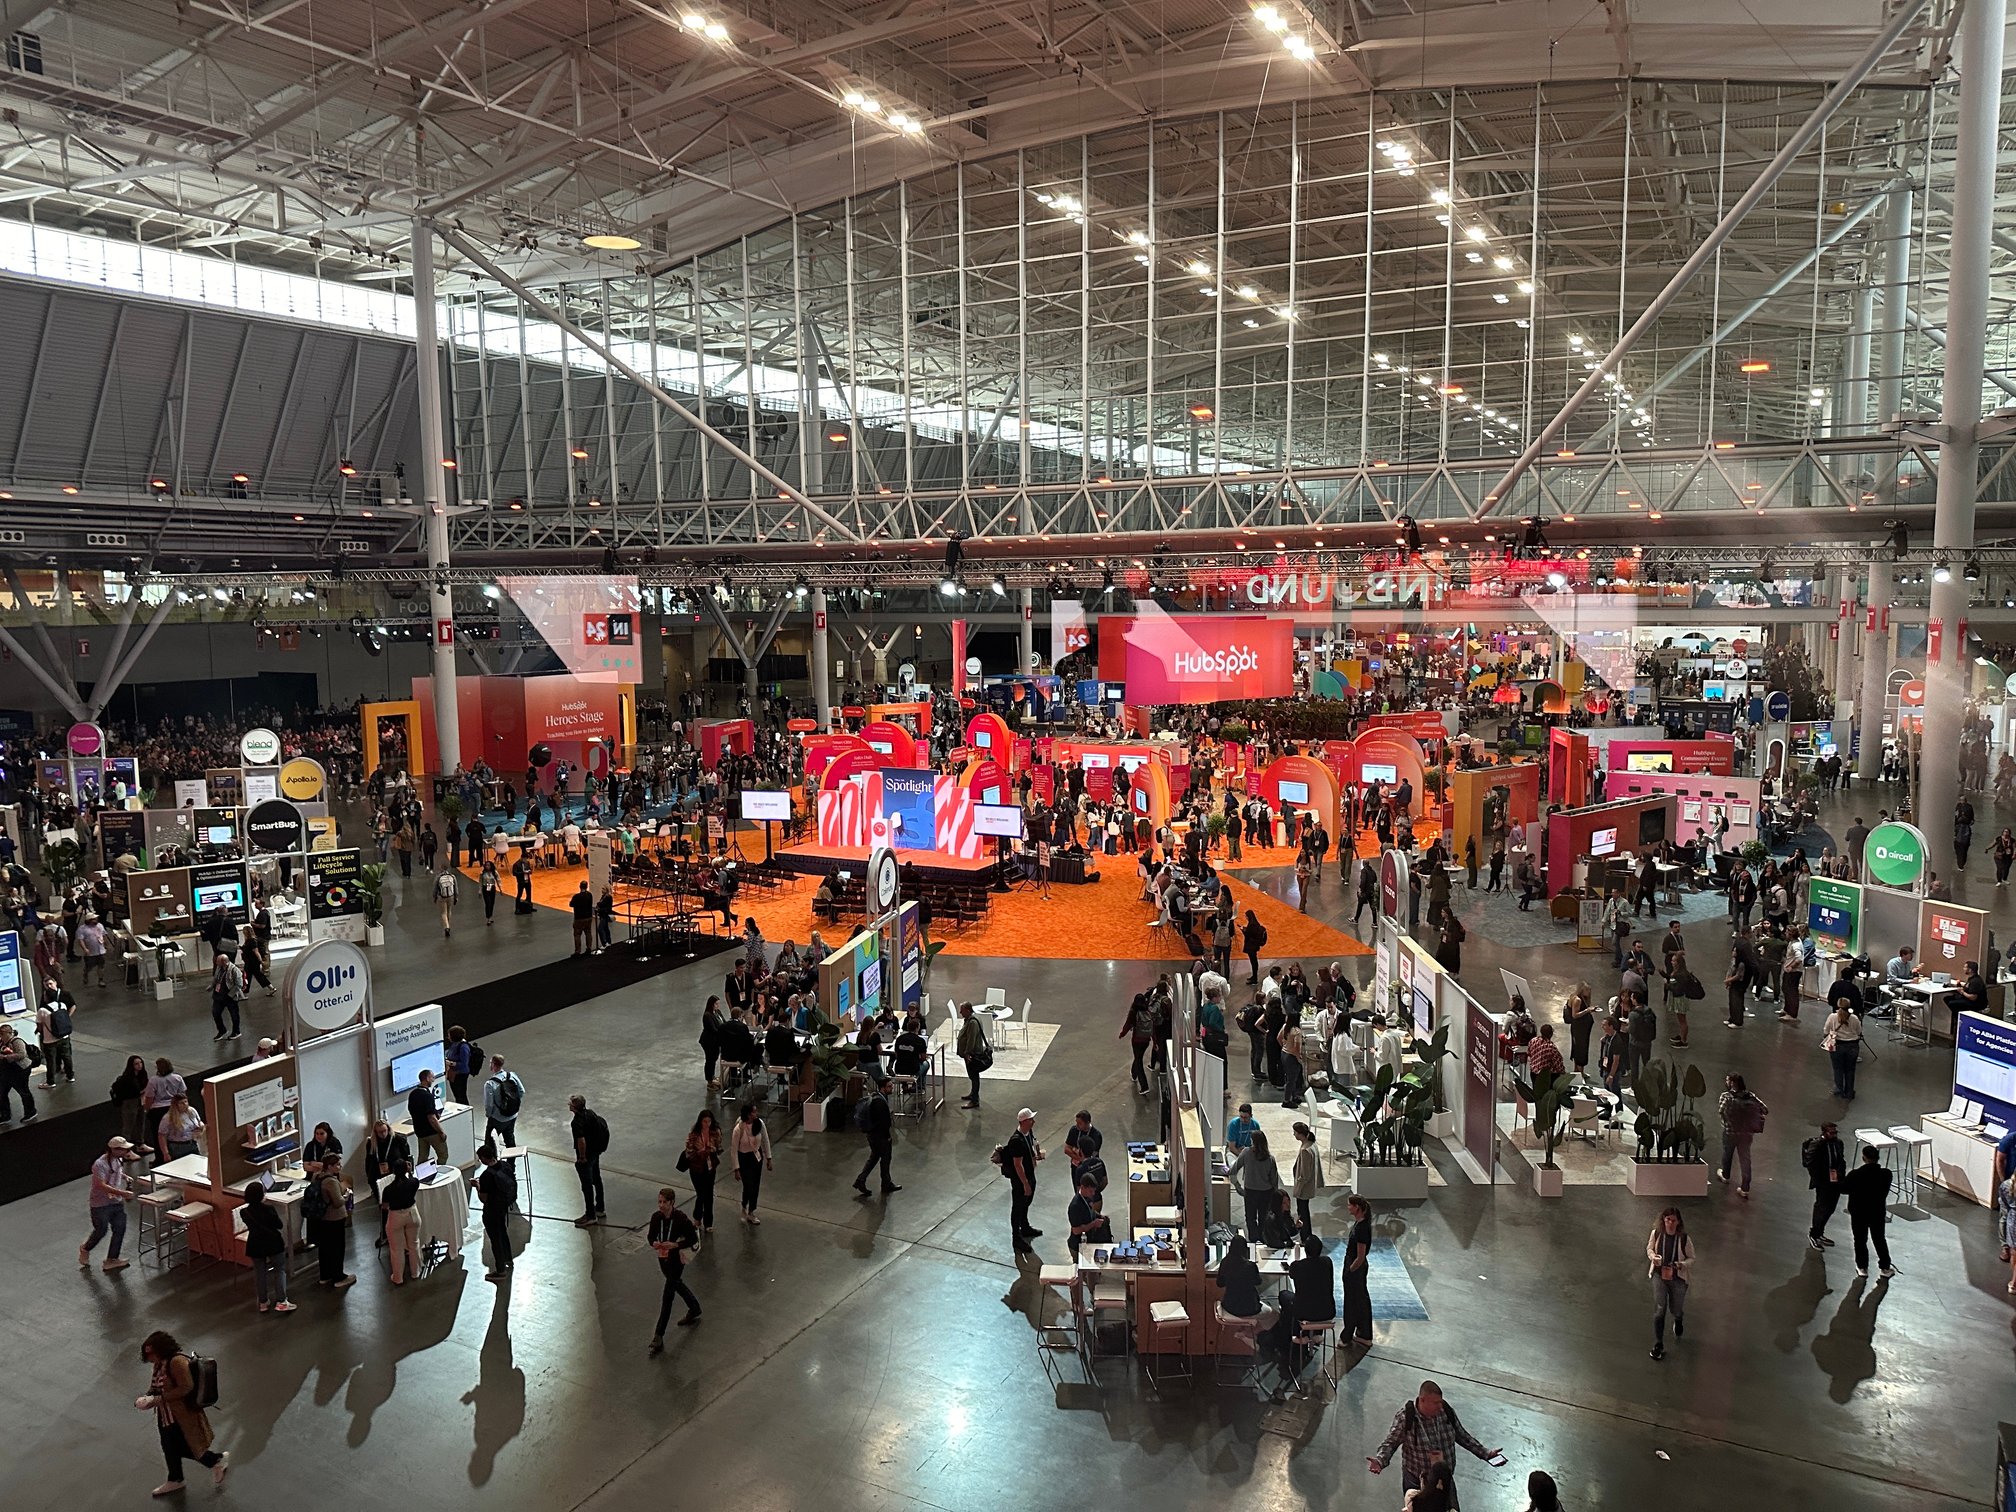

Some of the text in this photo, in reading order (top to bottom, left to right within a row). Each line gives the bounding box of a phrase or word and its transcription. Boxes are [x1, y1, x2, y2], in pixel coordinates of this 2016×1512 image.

[400, 602, 430, 613] FOO
[1175, 645, 1258, 676] HubSpot
[562, 701, 587, 712] HubSpot
[546, 712, 604, 727] Heroes Stage
[247, 740, 272, 749] blend
[886, 778, 932, 794] Spotlight
[251, 821, 298, 831] SmartBug.
[1889, 851, 1913, 862] aircall
[313, 862, 343, 870] Lifecycle
[325, 867, 356, 875] Solutions
[1385, 885, 1395, 899] asana
[314, 990, 353, 1010] Otter.ai
[386, 1026, 435, 1047] Meeting Assistant
[397, 1023, 420, 1036] Leading
[1477, 1020, 1489, 1039] asana
[1969, 1026, 2016, 1046] Top ABM Platfor
[1986, 1042, 2014, 1055] Agencies
[1470, 1052, 1491, 1080] management
[1473, 1066, 1487, 1087] platform
